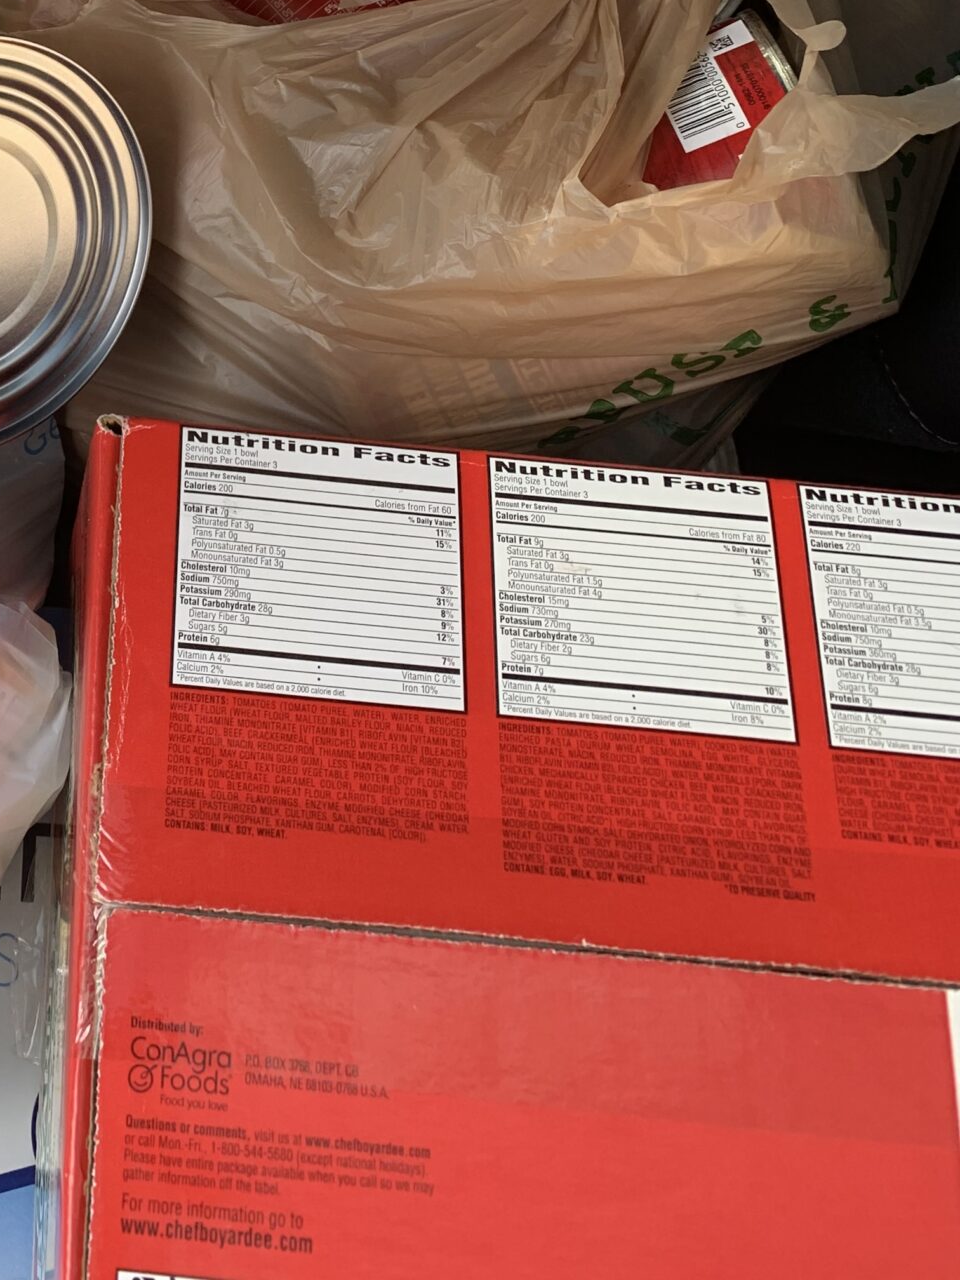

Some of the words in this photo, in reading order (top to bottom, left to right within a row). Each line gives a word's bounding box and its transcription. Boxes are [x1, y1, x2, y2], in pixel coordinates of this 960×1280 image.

[187, 430, 341, 457] Nutrition
[353, 446, 452, 468] Facts
[184, 481, 217, 493] Calories
[218, 483, 234, 493] 200
[494, 461, 650, 486] Nutrition
[663, 476, 762, 497] Facts
[804, 488, 960, 515] Nutrition
[495, 511, 529, 523] Calories
[530, 514, 546, 524] 200
[810, 539, 844, 550] Calories
[845, 542, 861, 552] 220
[180, 573, 210, 584] Sodium
[212, 574, 240, 588] 750mg
[180, 585, 222, 597] Potassium
[224, 588, 252, 601] 290mg
[130, 1016, 187, 1033] Distributed
[189, 1022, 204, 1036] by:
[130, 1036, 232, 1074] ConAgra
[160, 1065, 230, 1096] Foods
[125, 1115, 177, 1133] Questions
[179, 1122, 191, 1134] or
[193, 1123, 250, 1141] comments,
[304, 1134, 431, 1160] www.chefboyardee.com
[121, 1192, 143, 1211] For
[147, 1199, 183, 1217] more
[186, 1200, 265, 1225] information
[268, 1211, 288, 1230] go
[290, 1212, 304, 1230] to
[120, 1217, 314, 1254] www.chefboyardee.com
